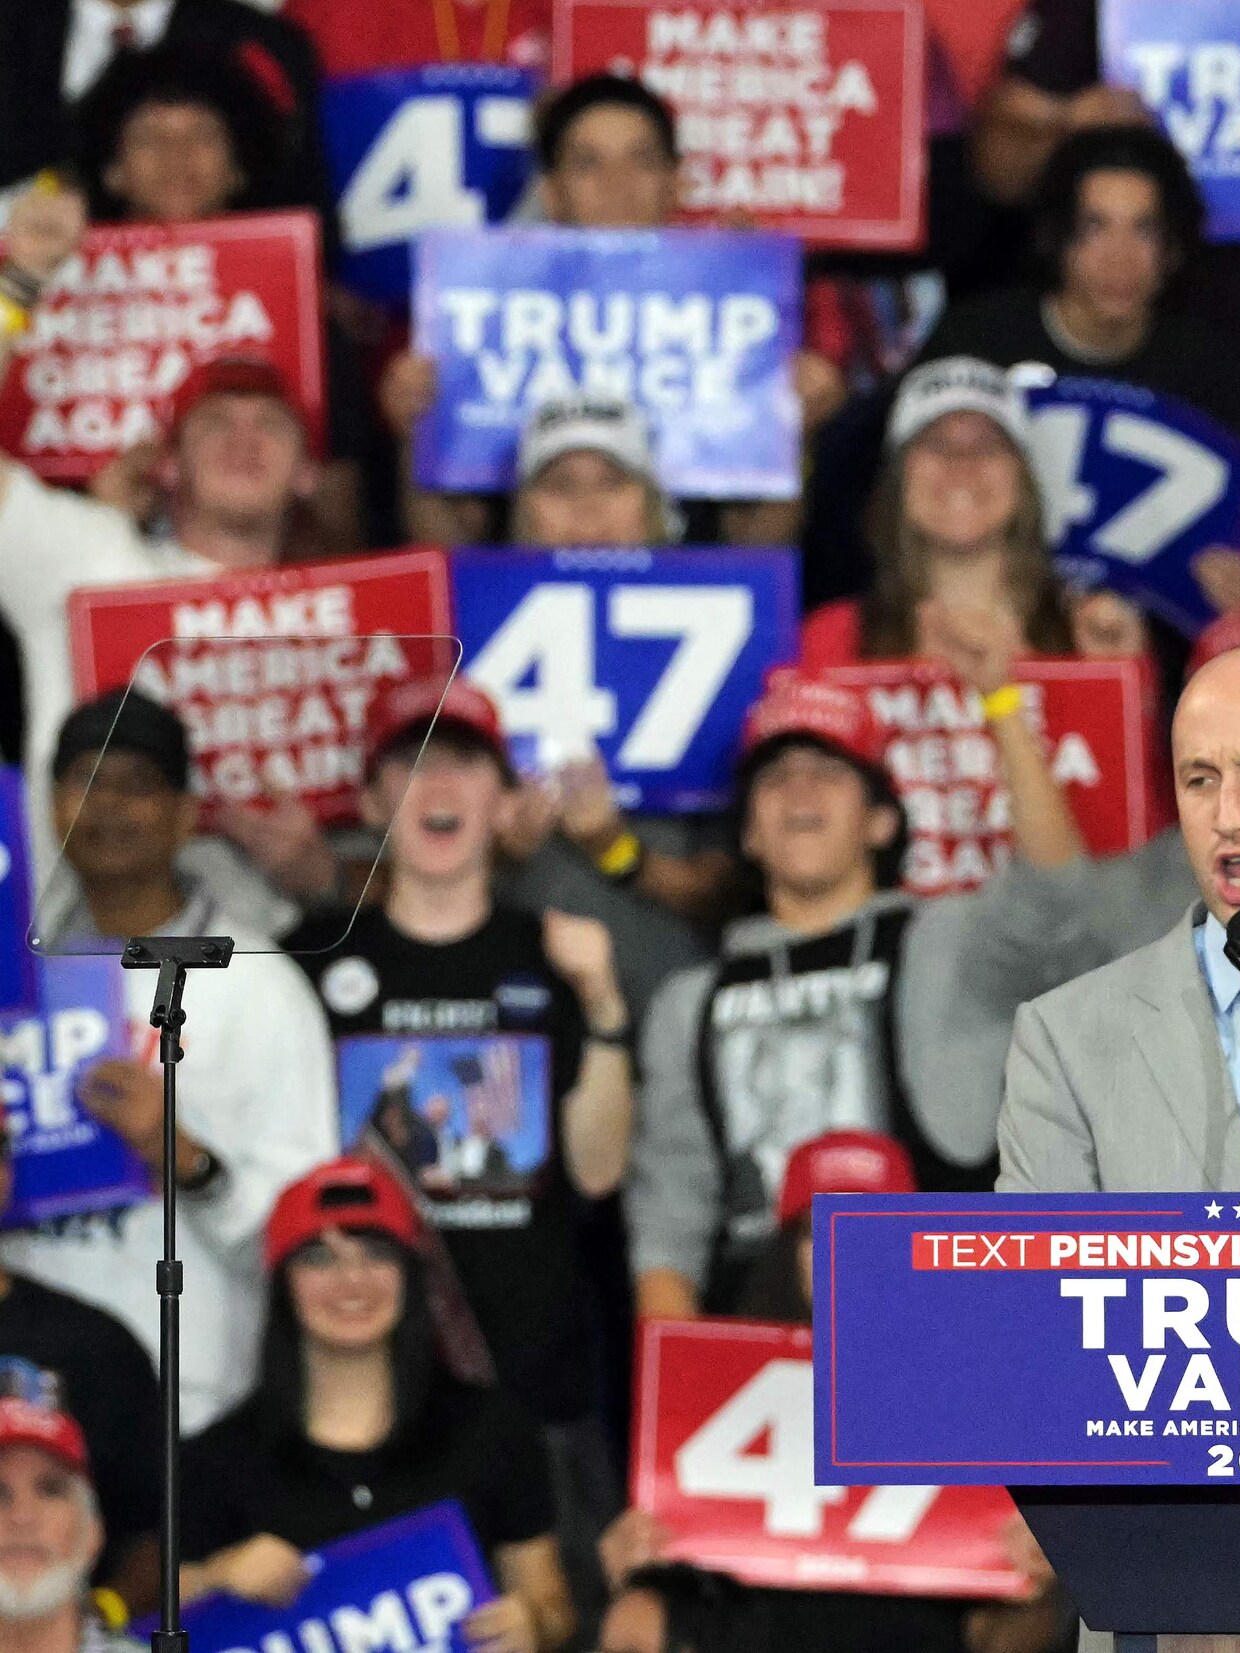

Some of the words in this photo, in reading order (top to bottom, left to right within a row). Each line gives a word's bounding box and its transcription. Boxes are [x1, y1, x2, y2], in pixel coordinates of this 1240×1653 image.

[646, 10, 828, 53] MAKE
[609, 56, 877, 115] MERICA
[674, 110, 842, 158] REAT
[16, 291, 275, 351] MERICA
[442, 288, 779, 356] TRUMP
[25, 347, 192, 402] GREA
[478, 350, 745, 408] VANCE
[172, 586, 356, 645] MAKE
[464, 582, 754, 771] 47
[923, 1234, 1035, 1267] TEXT
[1086, 1419, 1154, 1437] MAKE
